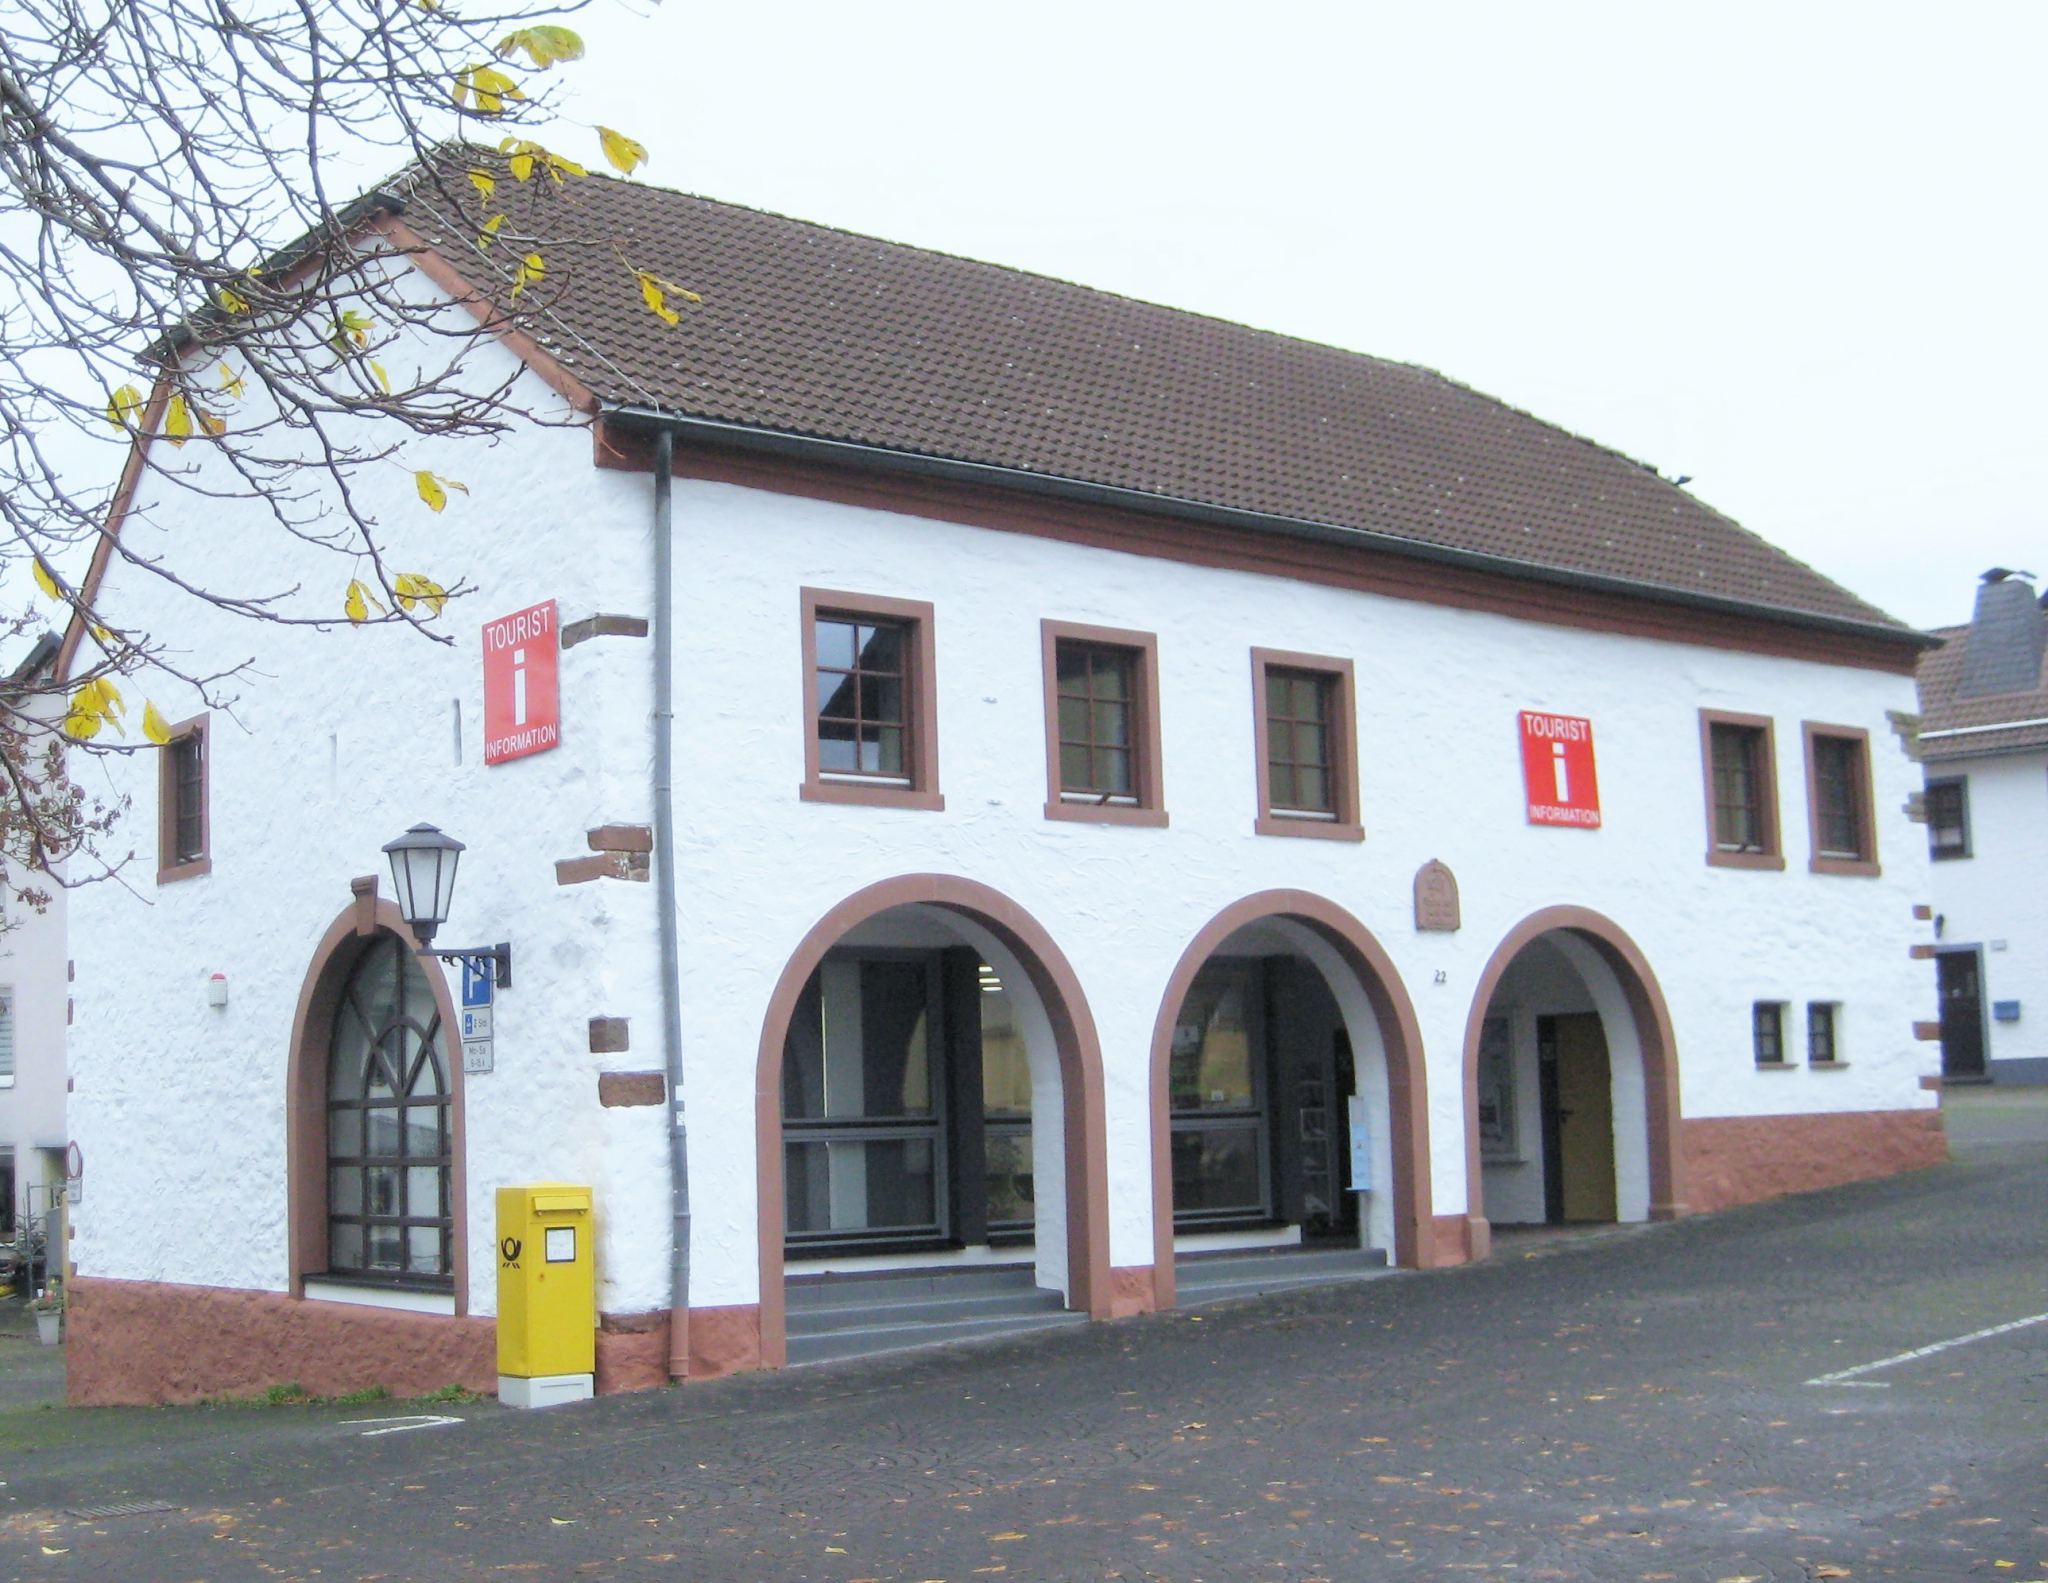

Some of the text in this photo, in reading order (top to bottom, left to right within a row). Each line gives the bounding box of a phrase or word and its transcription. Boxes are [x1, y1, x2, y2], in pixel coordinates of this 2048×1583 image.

[487, 606, 550, 651] TOURIST
[514, 648, 526, 727] i
[486, 723, 557, 760] INFORMATION
[1524, 714, 1588, 742] TOURIST
[1552, 742, 1569, 802] i
[1529, 804, 1600, 824] INFORMATION
[468, 953, 485, 999] P
